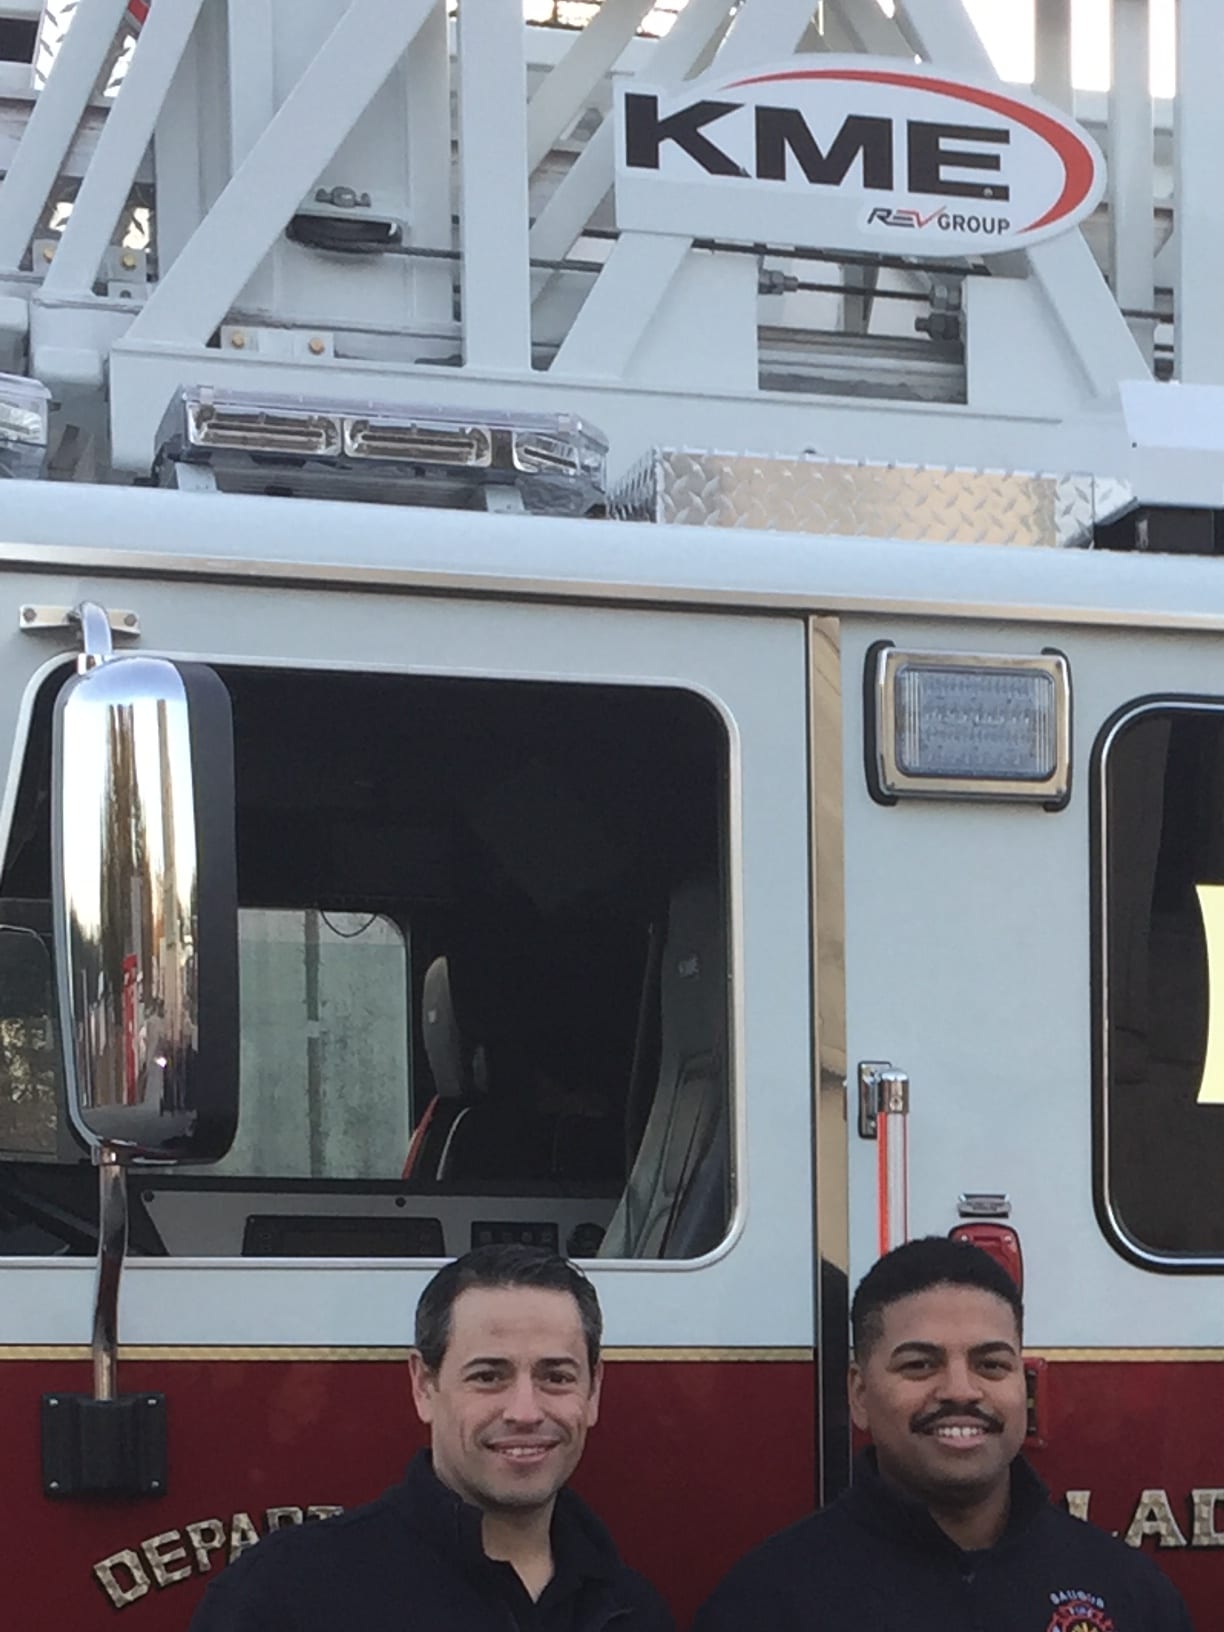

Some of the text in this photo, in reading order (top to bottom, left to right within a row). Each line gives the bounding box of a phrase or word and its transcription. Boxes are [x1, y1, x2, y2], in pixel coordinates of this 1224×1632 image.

[624, 92, 1011, 202] KME
[867, 204, 1010, 235] REV GROUP
[93, 1505, 344, 1608] DEPA
